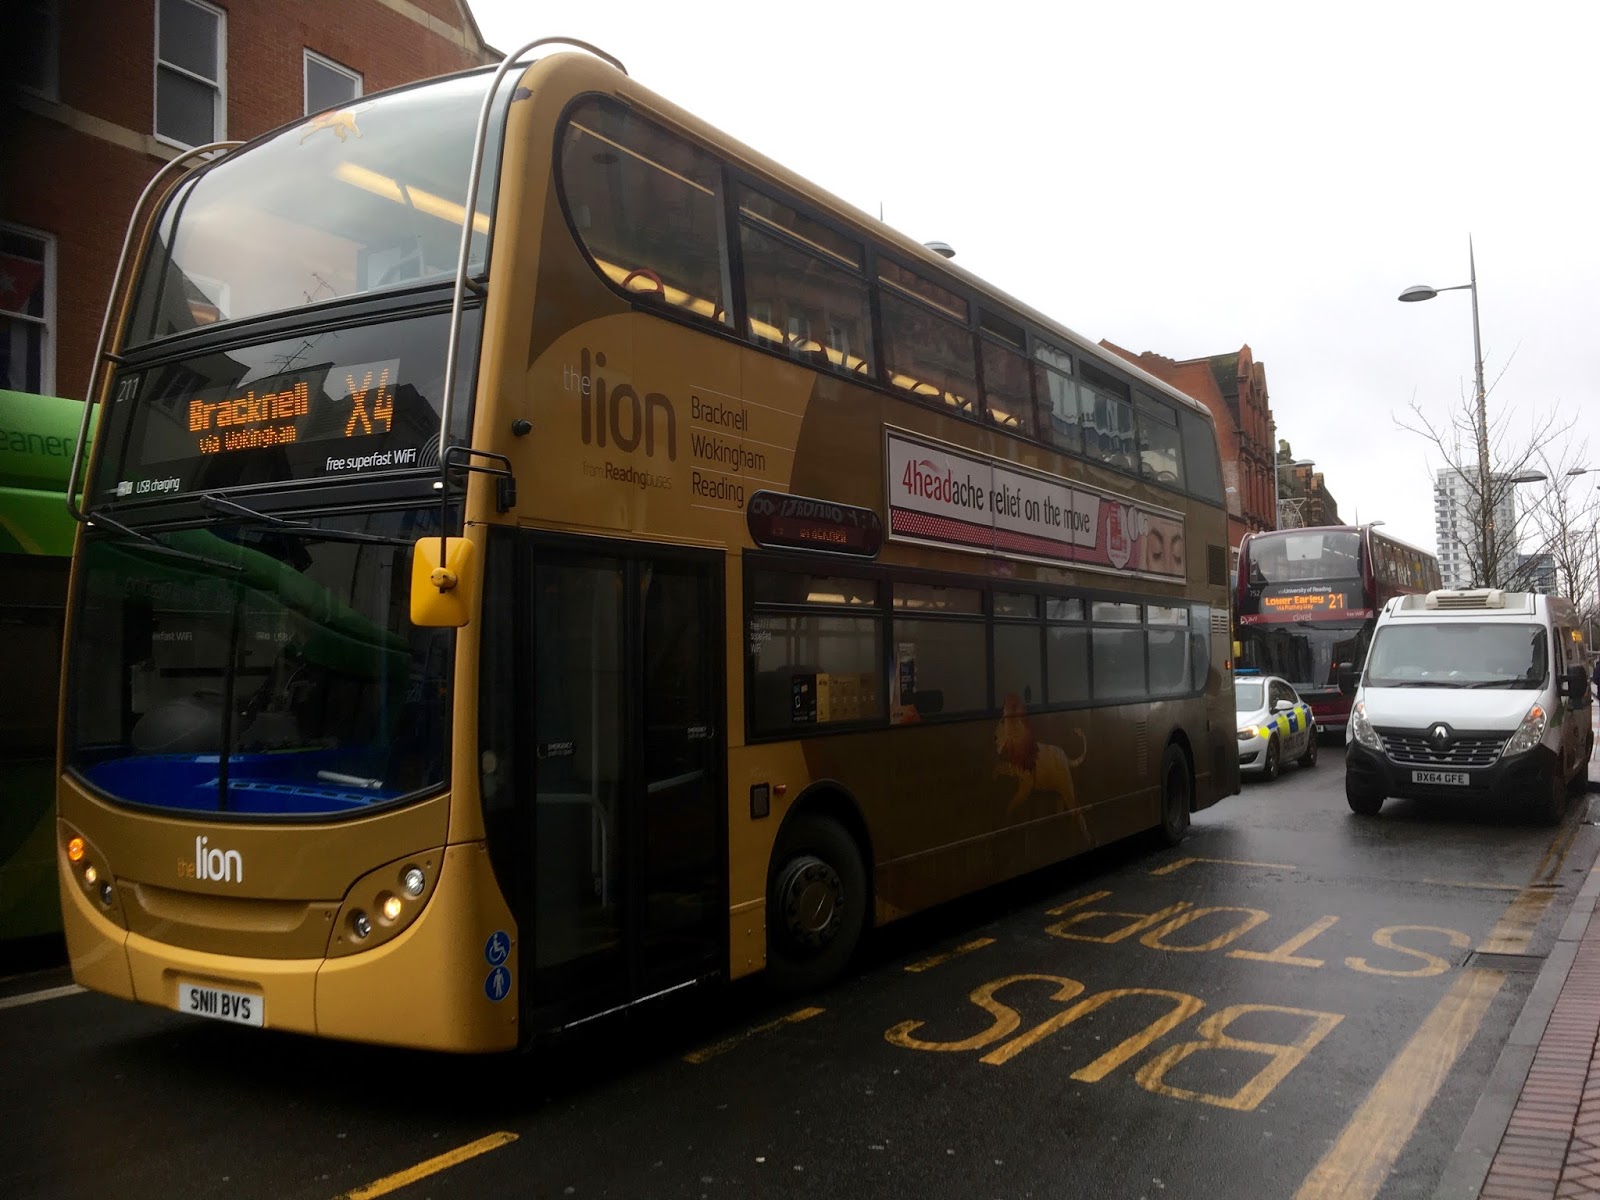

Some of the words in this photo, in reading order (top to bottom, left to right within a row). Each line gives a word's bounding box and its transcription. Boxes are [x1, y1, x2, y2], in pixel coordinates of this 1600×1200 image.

[116, 377, 139, 402] 211
[189, 381, 309, 432] Bracknell
[344, 368, 393, 438] X4
[563, 363, 591, 395] the
[581, 348, 677, 462] lion
[691, 395, 749, 432] Bracknell
[199, 436, 221, 454] via
[224, 425, 297, 451] Wokingham
[691, 432, 766, 472] Wokingham
[326, 456, 346, 471] free
[346, 451, 392, 472] superfast
[393, 448, 417, 464] WiFi
[136, 480, 151, 493] USB
[151, 476, 180, 492] charging
[691, 471, 744, 508] Reading
[902, 459, 985, 510] 4headache
[989, 484, 1022, 518] relief
[1024, 499, 1040, 522] on
[1043, 495, 1061, 526] the
[1063, 507, 1091, 534] move
[1265, 596, 1292, 606] Lower
[1294, 594, 1324, 605] Earley
[1328, 592, 1344, 609] 21
[1283, 586, 1306, 595] University
[1313, 585, 1332, 594] Reading
[1416, 773, 1442, 783] BX64
[1444, 774, 1465, 784] GFE
[195, 835, 243, 884] lion
[1044, 901, 1471, 978] STOP
[189, 987, 219, 1015] SN11
[220, 993, 251, 1021] BVS
[885, 974, 1346, 1111] BUS
